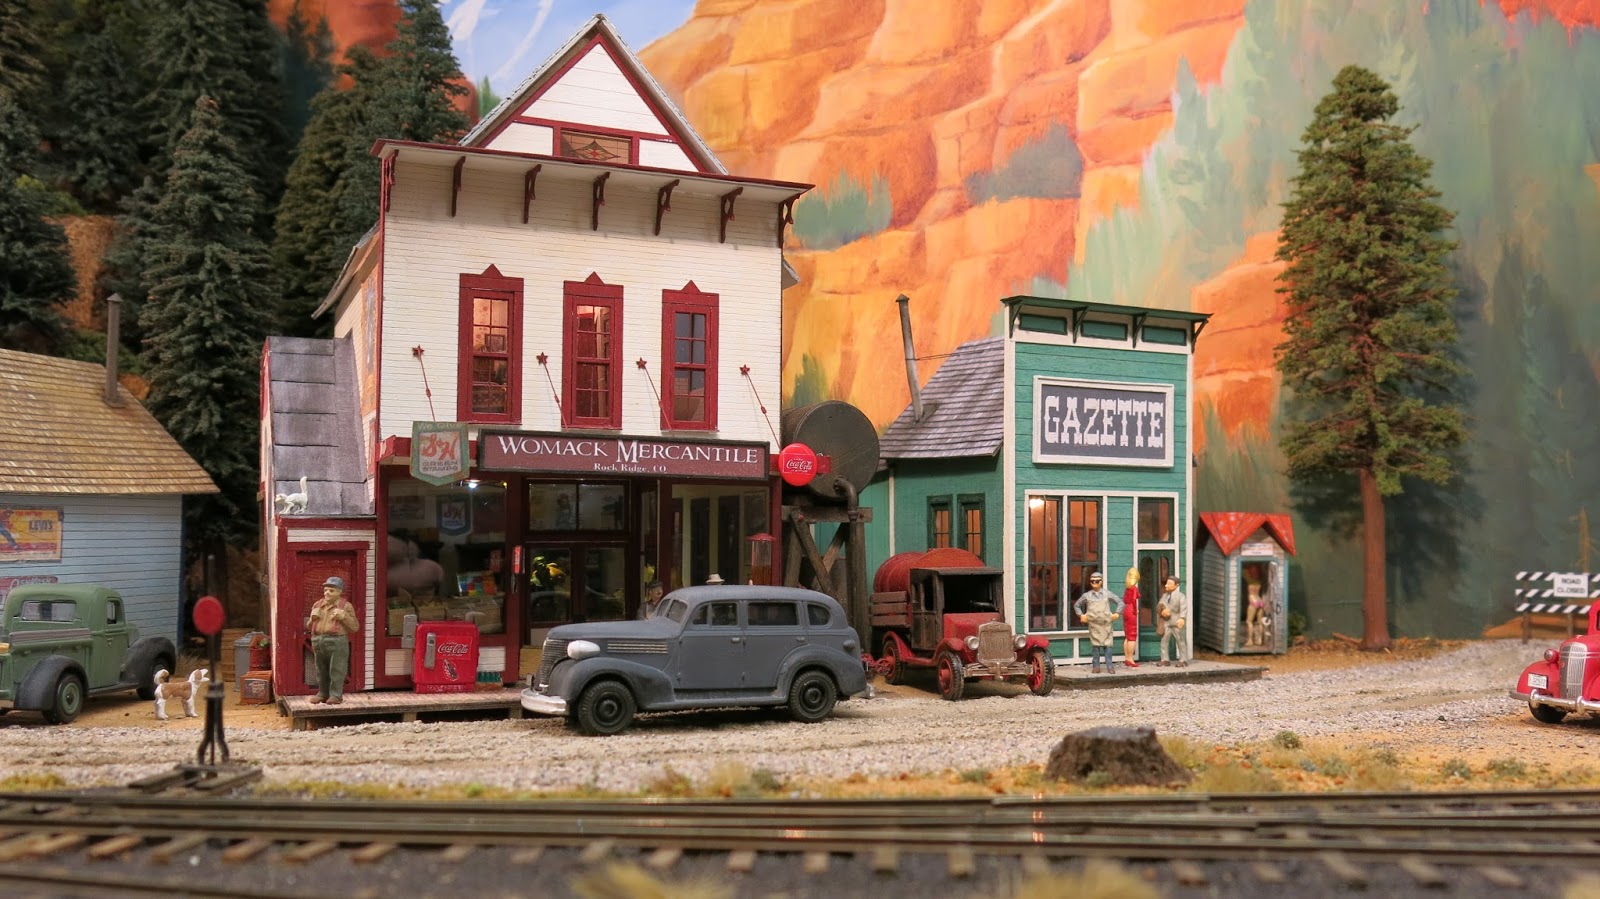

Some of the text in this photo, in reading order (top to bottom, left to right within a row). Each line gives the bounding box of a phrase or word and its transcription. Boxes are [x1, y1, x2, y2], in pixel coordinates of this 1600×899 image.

[1044, 395, 1164, 448] GAZETTE
[497, 435, 758, 464] WOMACK MERCANTILE
[594, 463, 618, 471] Rock
[653, 465, 667, 473] CO
